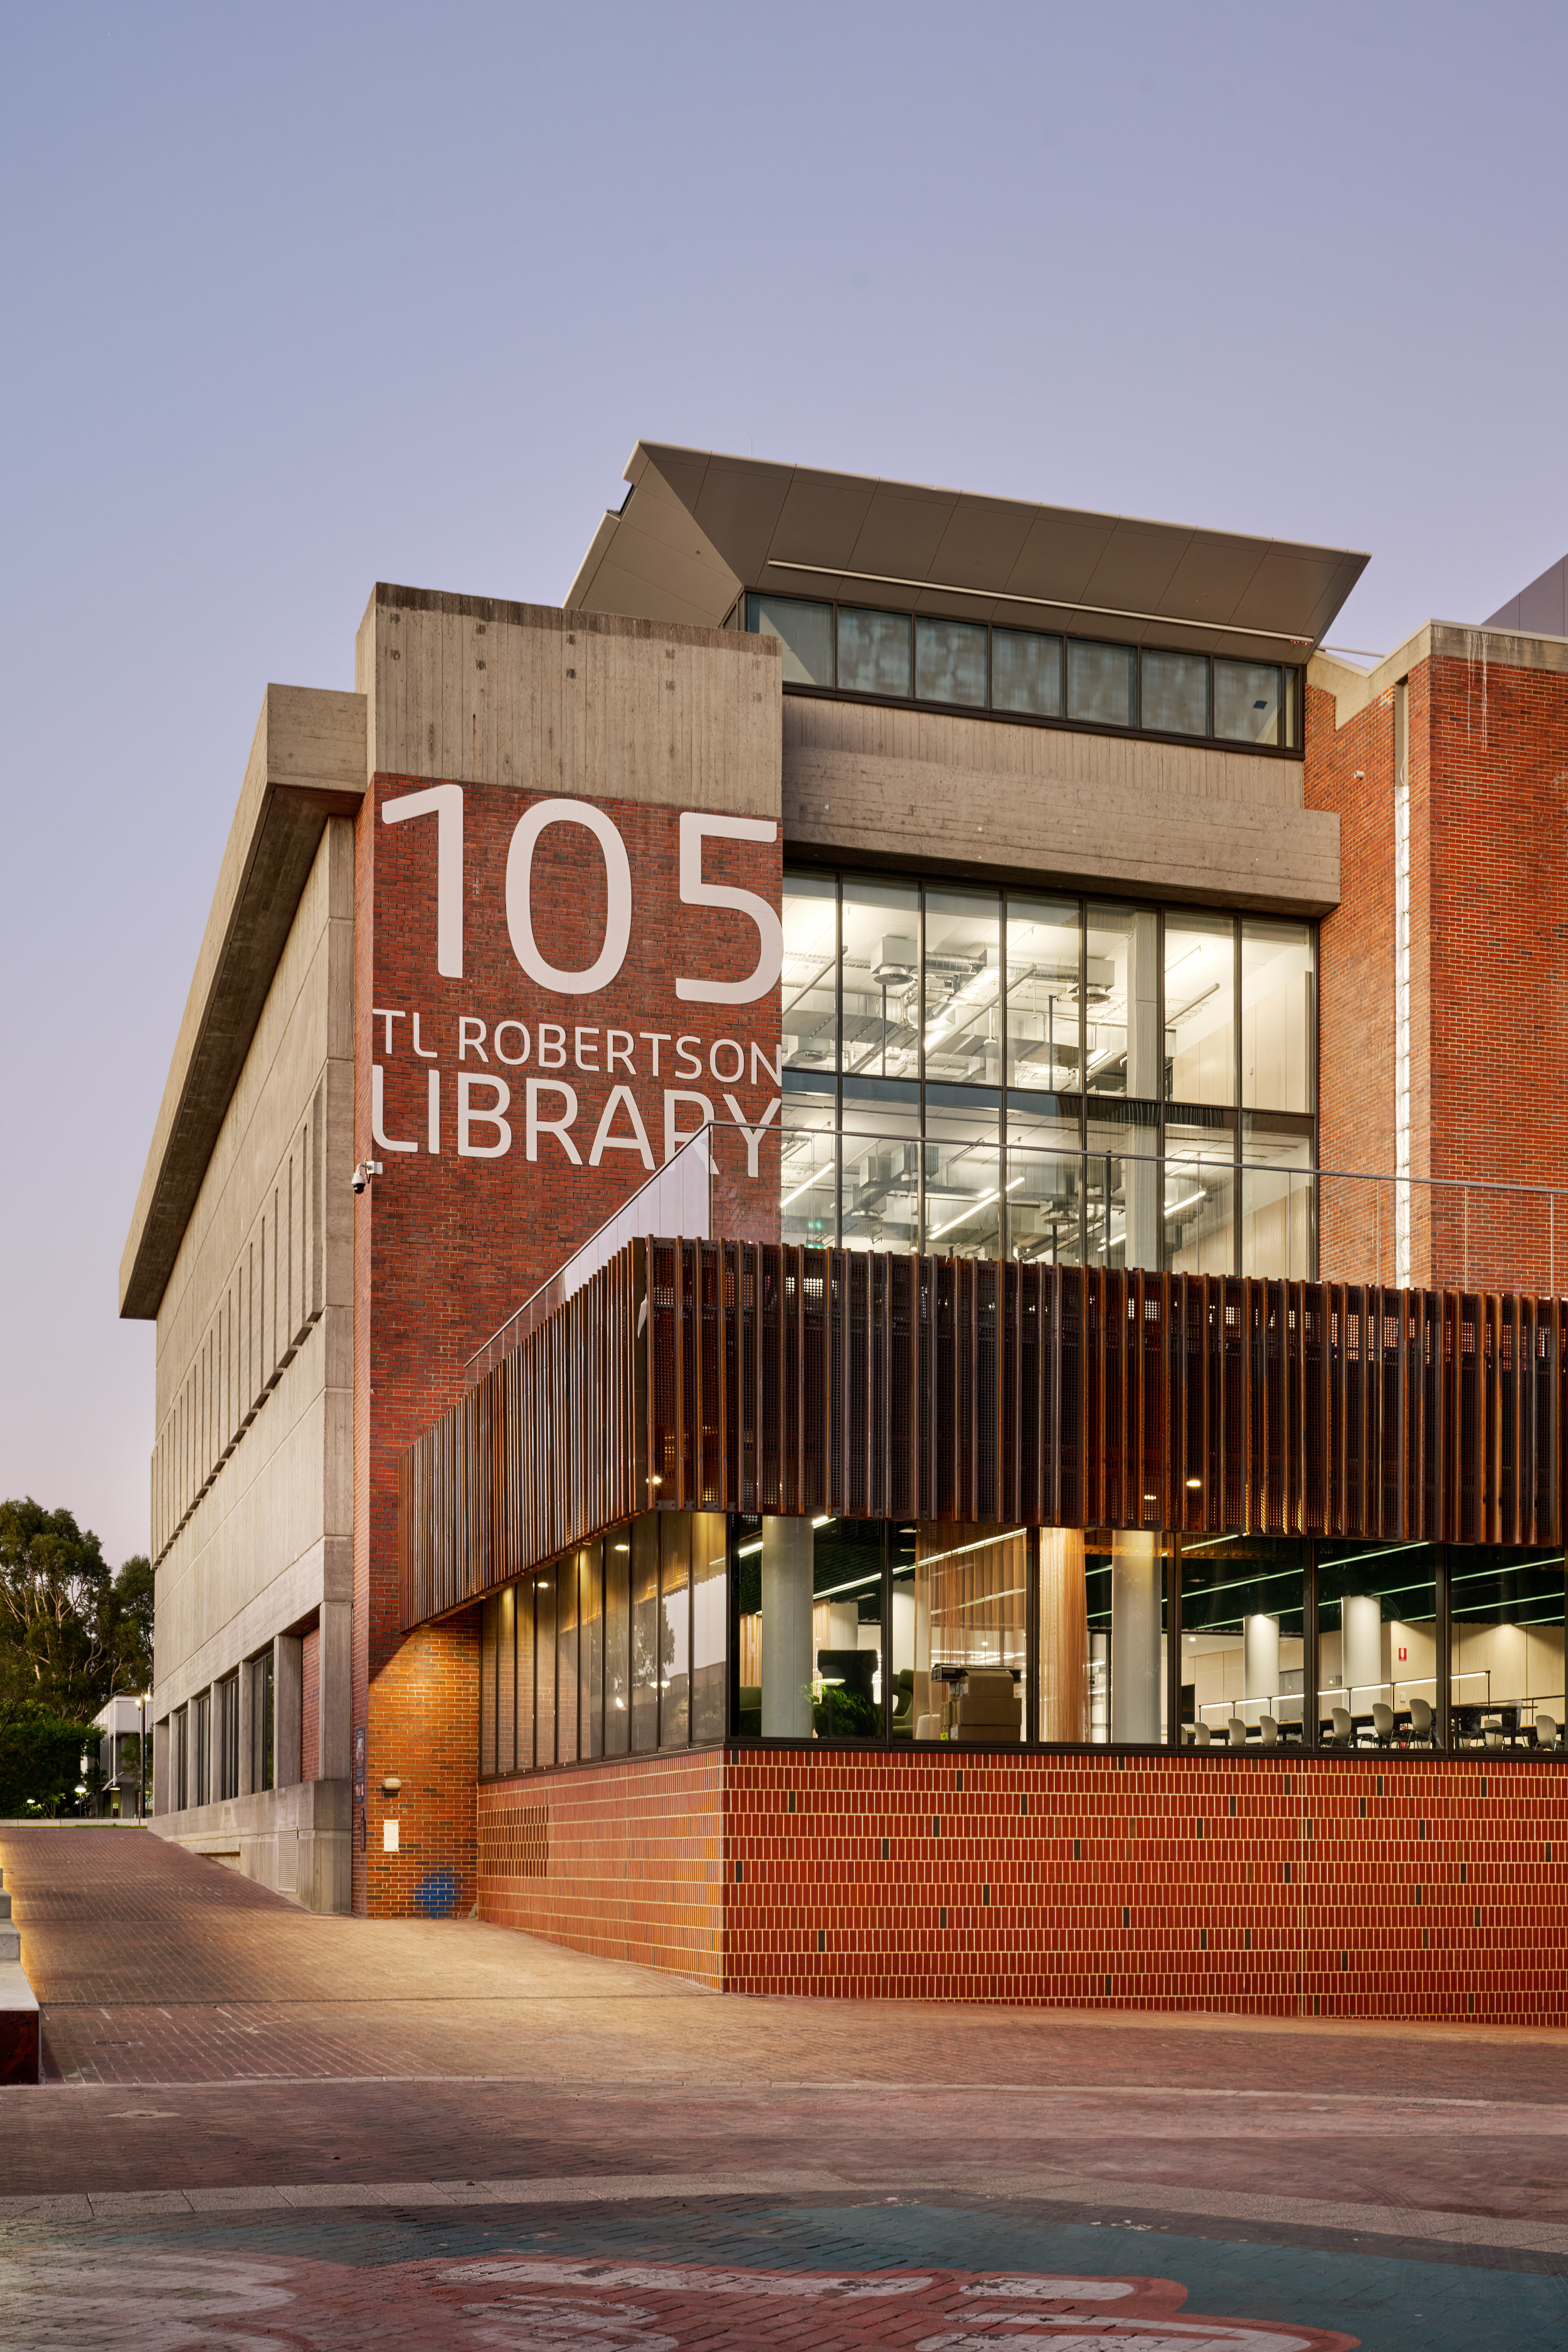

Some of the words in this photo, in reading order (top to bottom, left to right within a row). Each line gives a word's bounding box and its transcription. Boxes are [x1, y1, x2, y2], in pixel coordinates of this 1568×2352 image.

[381, 784, 784, 1004] 105
[372, 1008, 438, 1058] TL
[458, 1016, 782, 1088] ROBERTSON
[372, 1064, 782, 1178] LIBRARY
